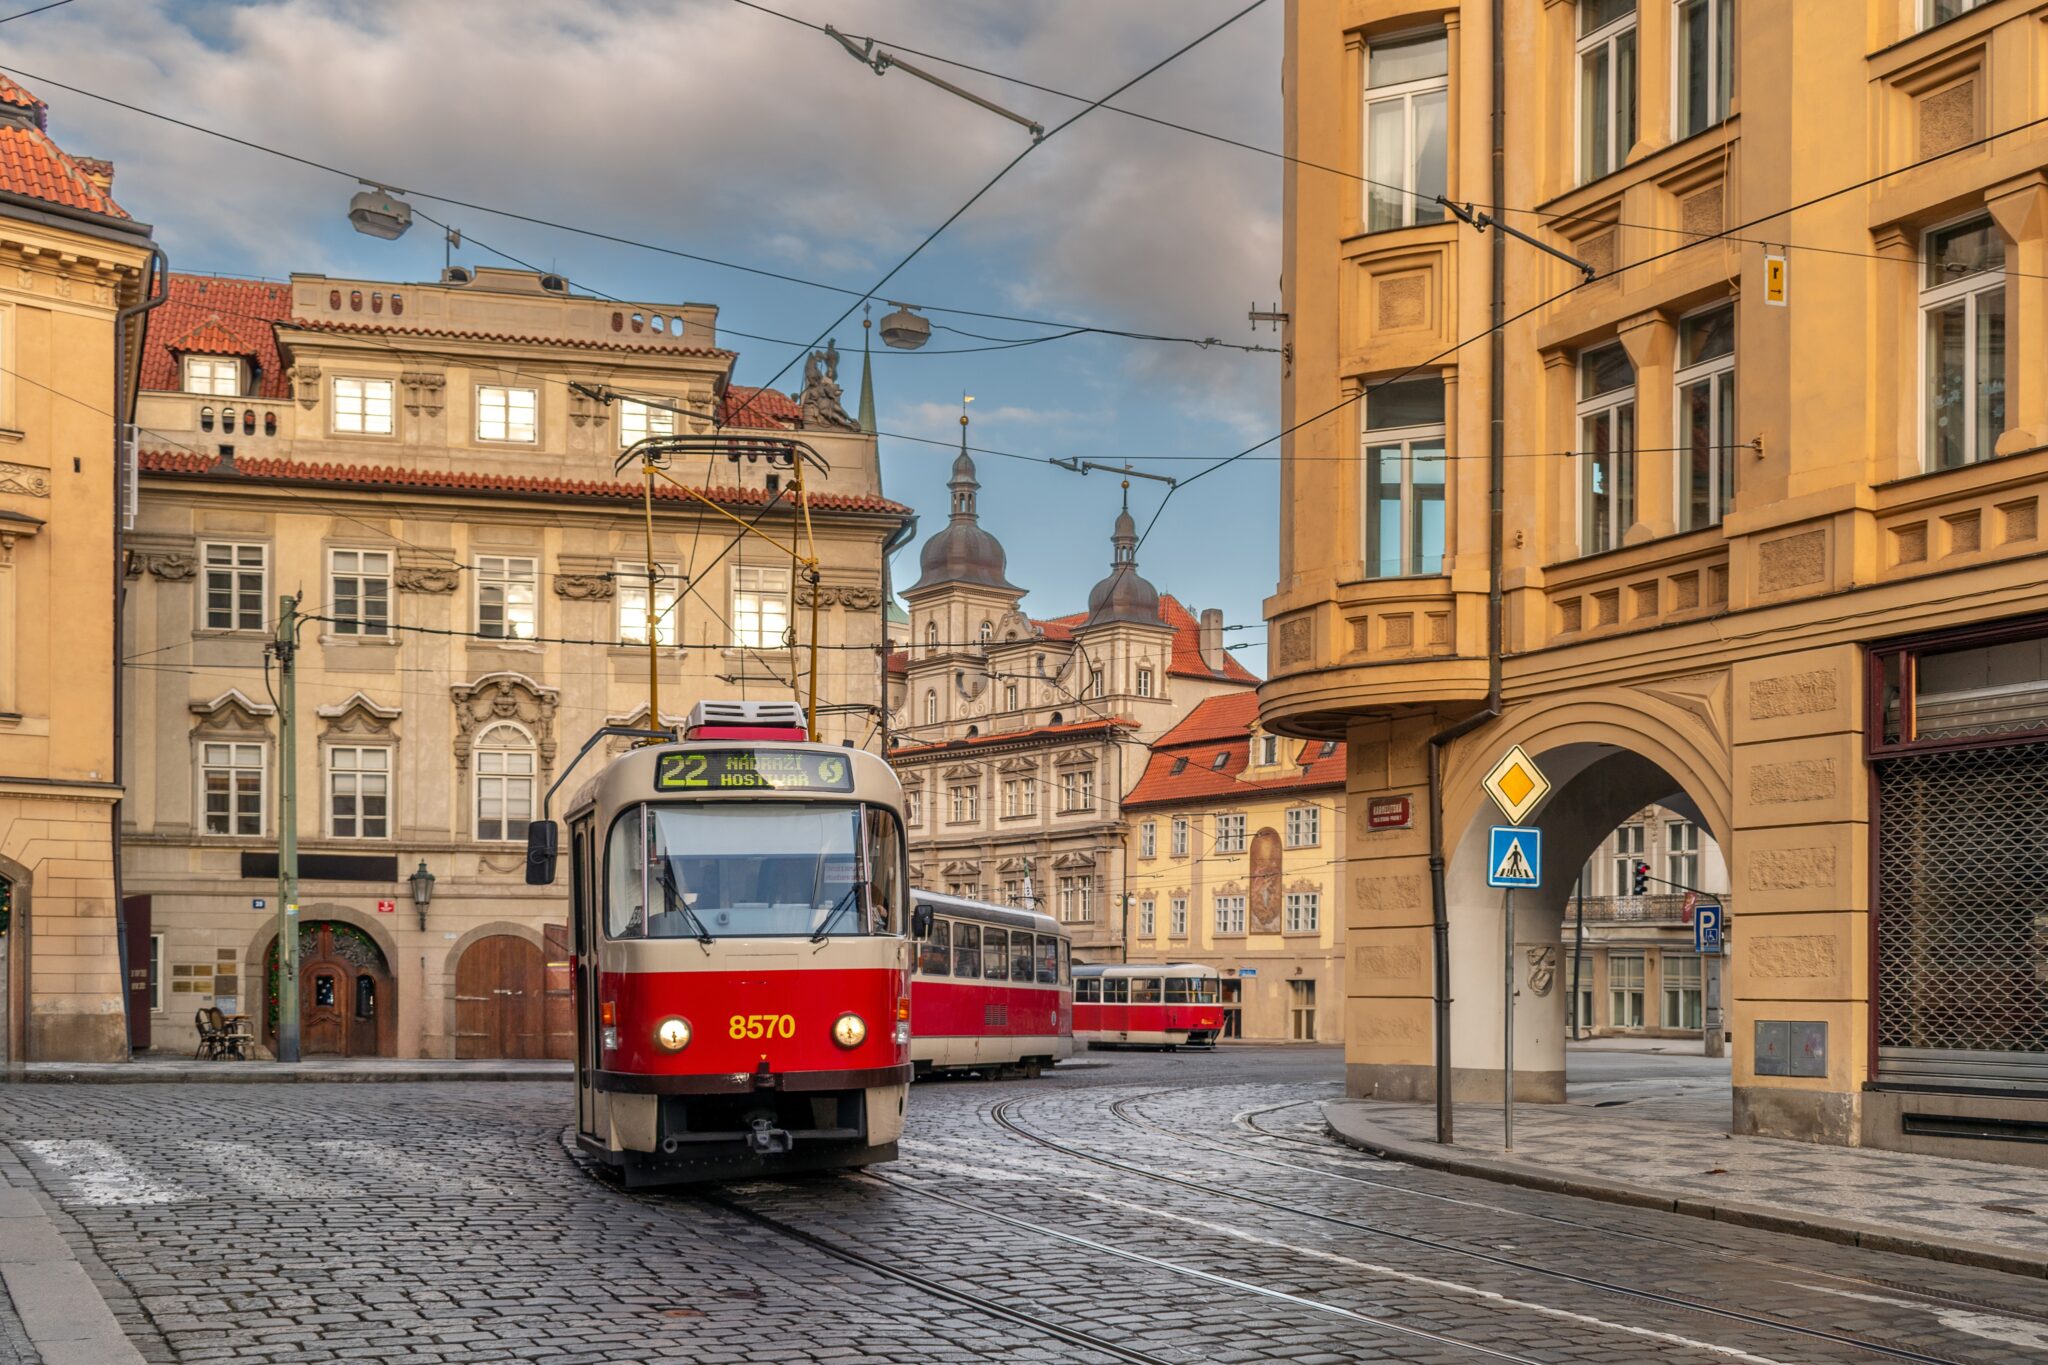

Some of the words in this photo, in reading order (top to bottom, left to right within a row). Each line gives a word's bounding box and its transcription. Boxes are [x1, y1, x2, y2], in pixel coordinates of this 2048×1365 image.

[662, 754, 709, 787] 22
[1700, 911, 1716, 951] P
[728, 1014, 796, 1040] 8570
